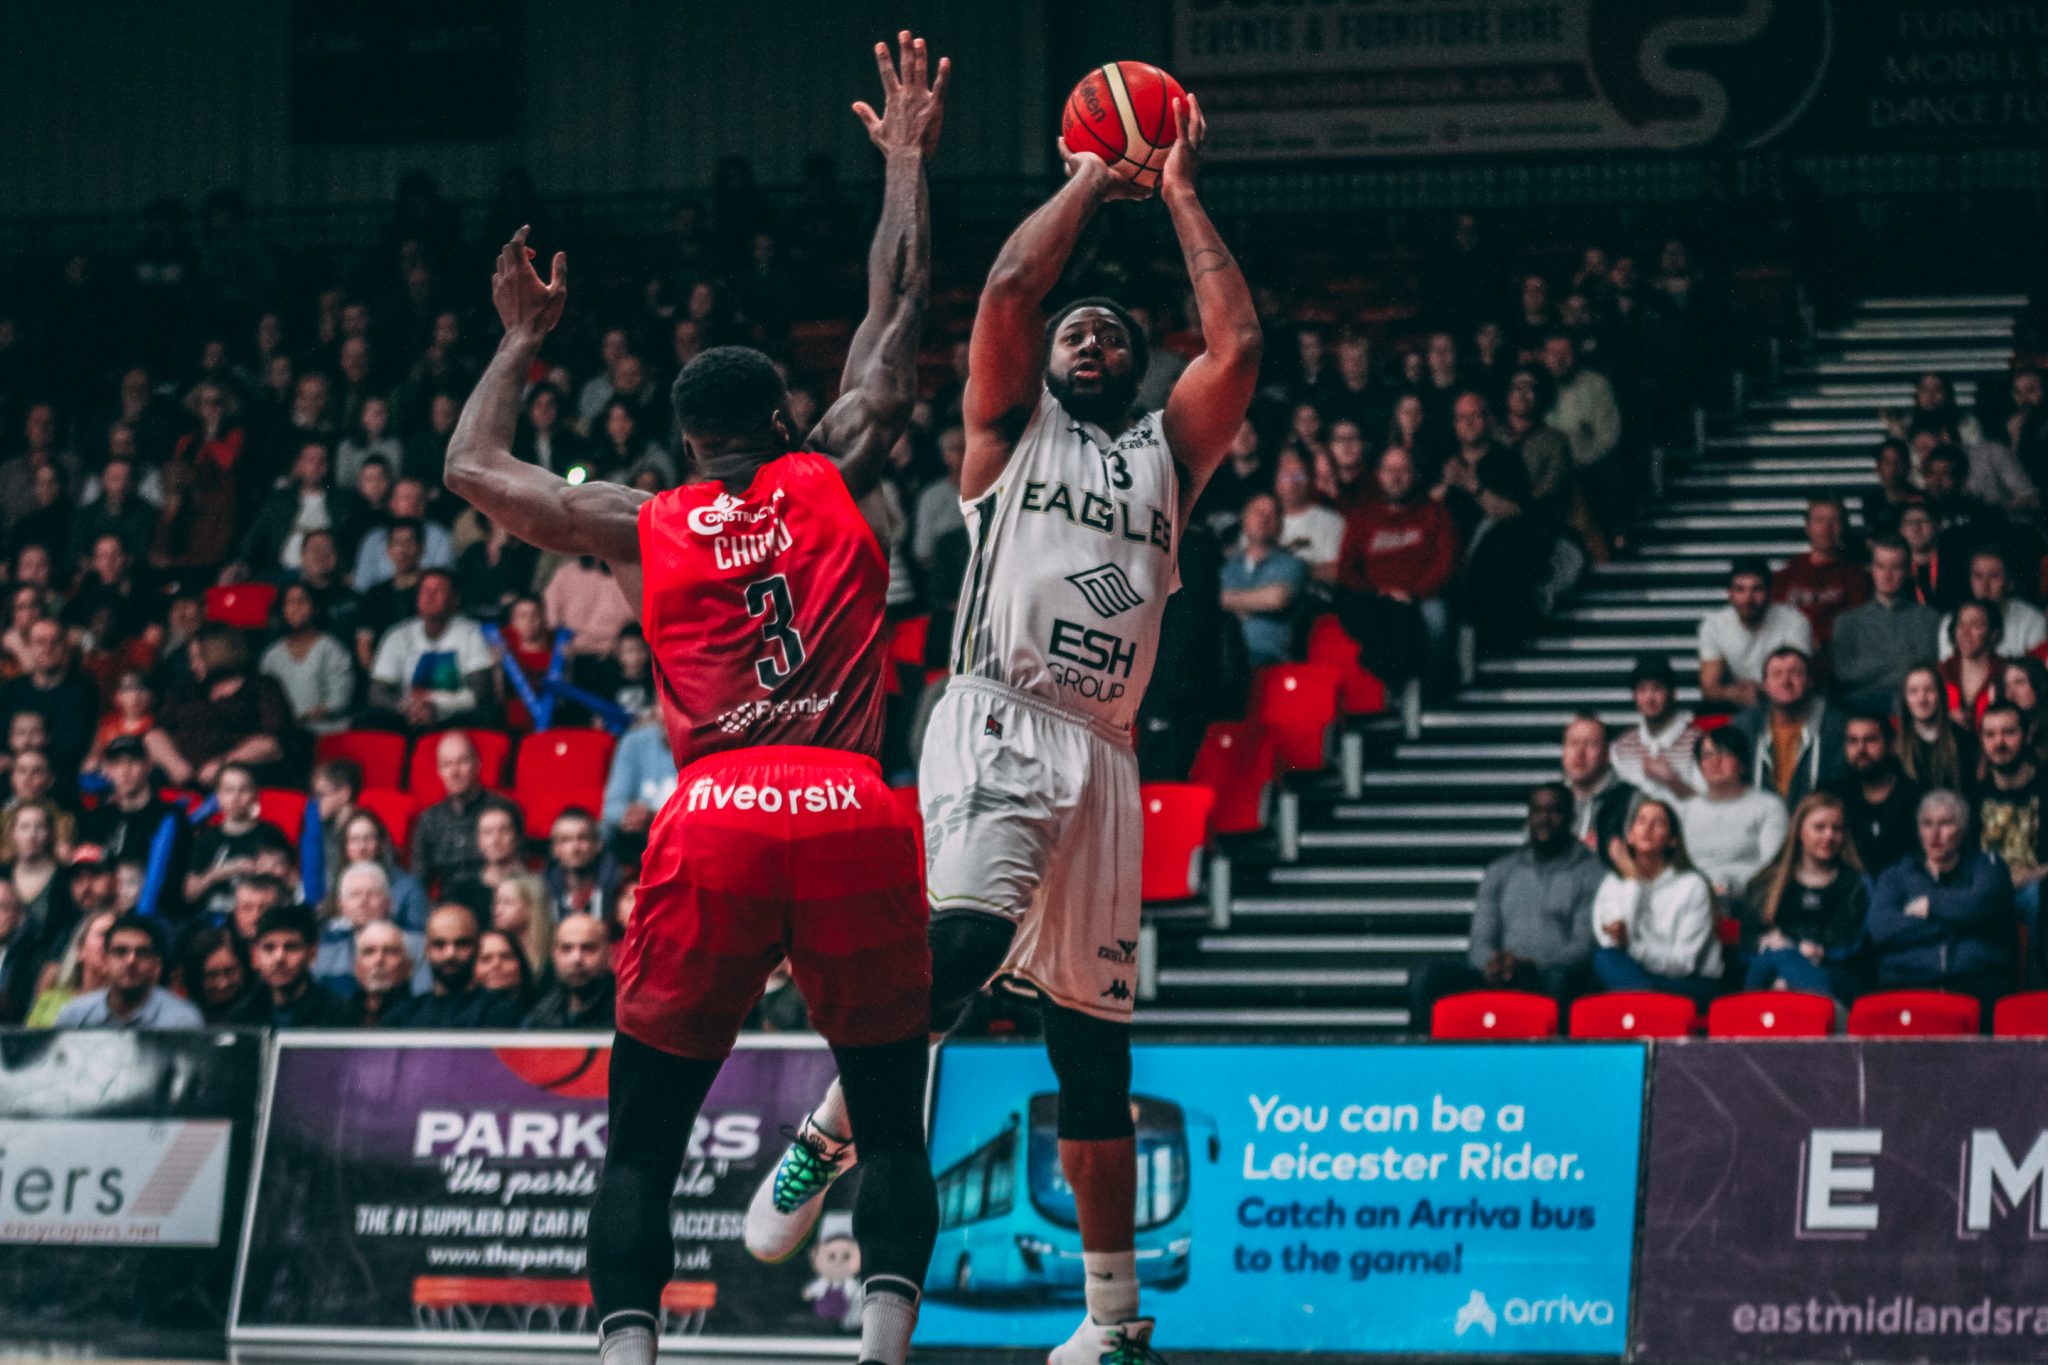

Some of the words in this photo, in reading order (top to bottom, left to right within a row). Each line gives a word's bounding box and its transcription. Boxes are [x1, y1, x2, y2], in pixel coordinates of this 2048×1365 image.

[1021, 479, 1171, 555] EAGLES
[744, 573, 806, 691] 3
[1049, 618, 1137, 679] ESH
[1046, 662, 1125, 703] GROUP
[1249, 1094, 1328, 1132] You
[1340, 1104, 1419, 1132] can
[1432, 1094, 1485, 1132] be
[1496, 1104, 1525, 1132] a
[415, 1111, 760, 1159] PARKRS
[1243, 1142, 1448, 1180] Leicester
[1459, 1142, 1585, 1181] Rider.
[356, 1205, 391, 1235] THE
[420, 1206, 504, 1236] SUPPLIER
[508, 1208, 527, 1236] OF
[531, 1208, 567, 1237] CAR
[672, 1210, 747, 1240] ACCESS
[1237, 1197, 1346, 1229] Catch
[1355, 1203, 1400, 1229] an
[1409, 1197, 1521, 1230] Arriva
[1530, 1197, 1596, 1230] bus
[1234, 1244, 1272, 1273] to
[1282, 1242, 1341, 1273] the
[1350, 1243, 1464, 1281] game!
[1504, 1293, 1614, 1326] arriva
